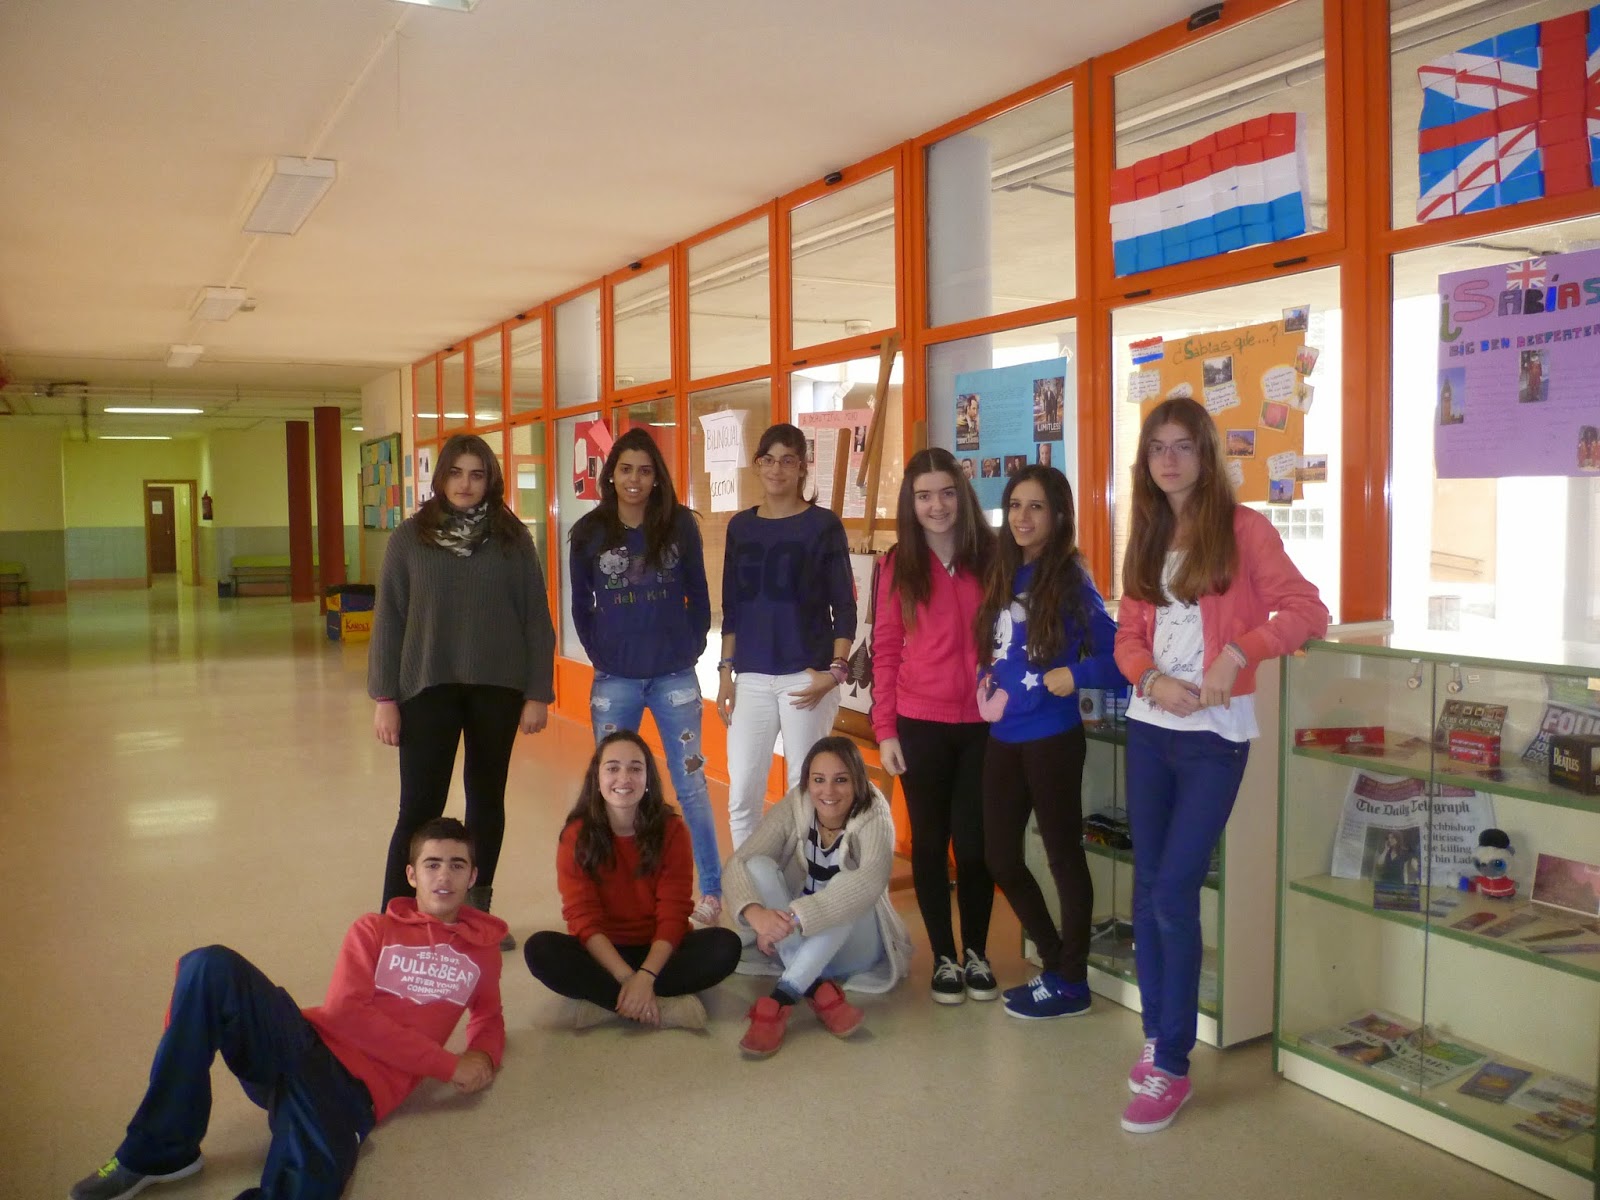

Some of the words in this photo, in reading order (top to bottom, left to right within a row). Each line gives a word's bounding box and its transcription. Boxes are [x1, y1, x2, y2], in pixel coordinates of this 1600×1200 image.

[706, 425, 739, 451] BILINGUAL
[711, 478, 735, 497] SECTION
[1470, 719, 1501, 730] LONDON
[1553, 747, 1580, 772] BEATLES
[1356, 798, 1380, 815] The
[1382, 803, 1409, 817] Daily
[1411, 799, 1470, 815] Telgraph
[1440, 843, 1472, 855] killing
[1435, 854, 1450, 864] bin
[1453, 854, 1473, 864] Lad
[401, 975, 414, 983] AN
[415, 977, 435, 987] EVER
